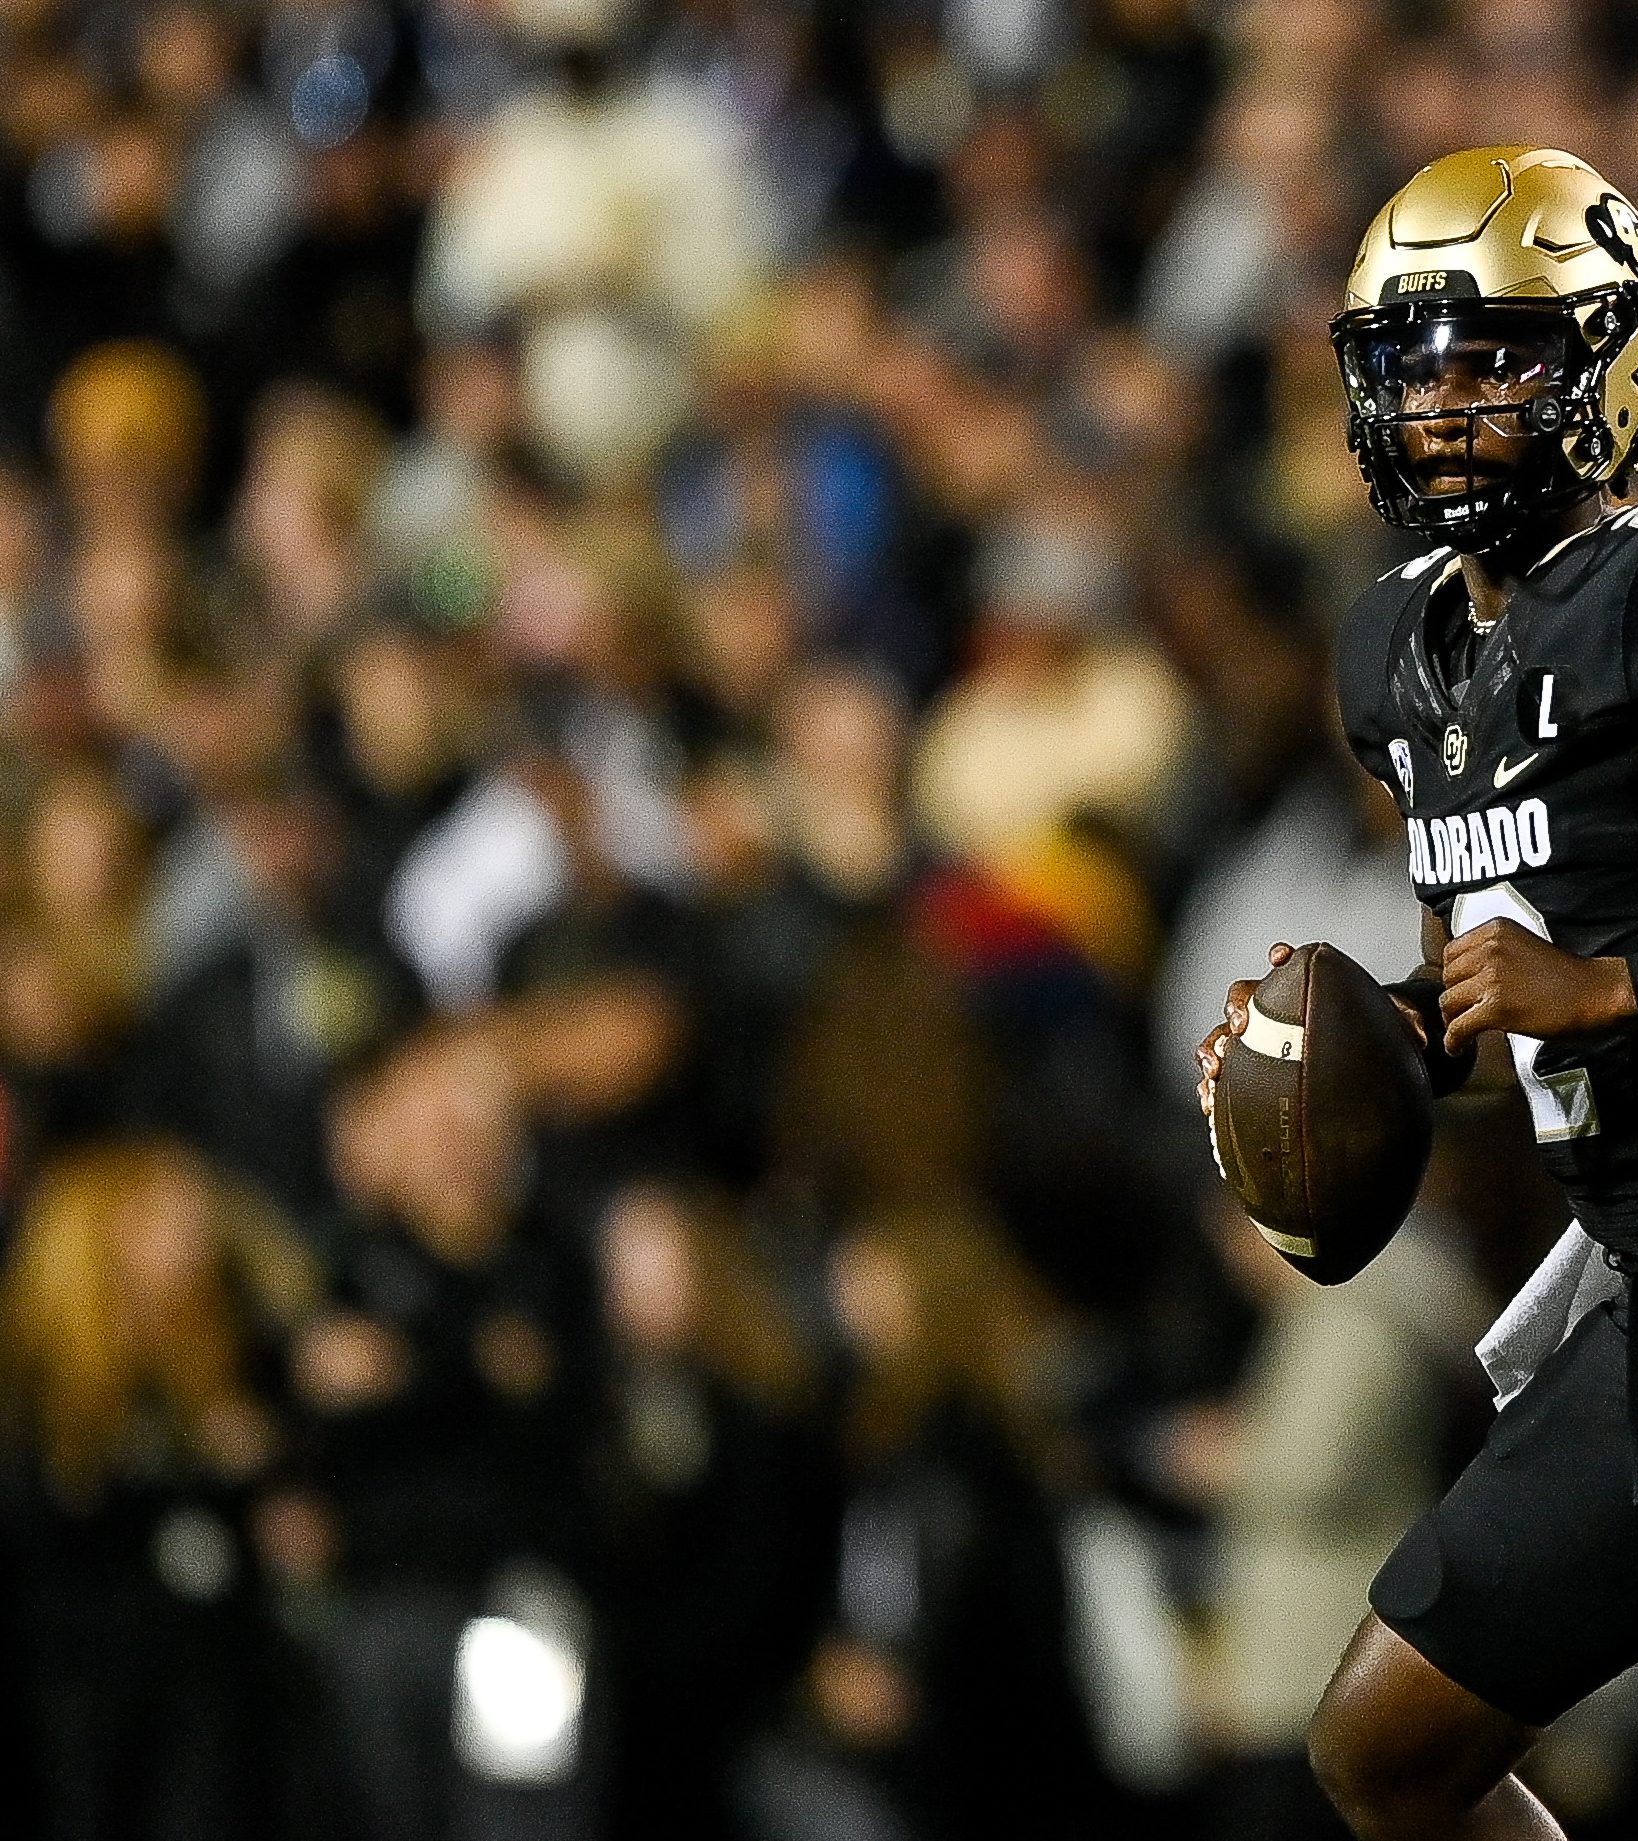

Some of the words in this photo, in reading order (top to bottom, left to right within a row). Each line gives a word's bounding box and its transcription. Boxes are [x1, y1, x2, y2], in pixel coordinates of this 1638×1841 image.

[1397, 271, 1448, 294] BUFFS
[1538, 674, 1558, 739] L
[1407, 797, 1552, 885] OLORADO
